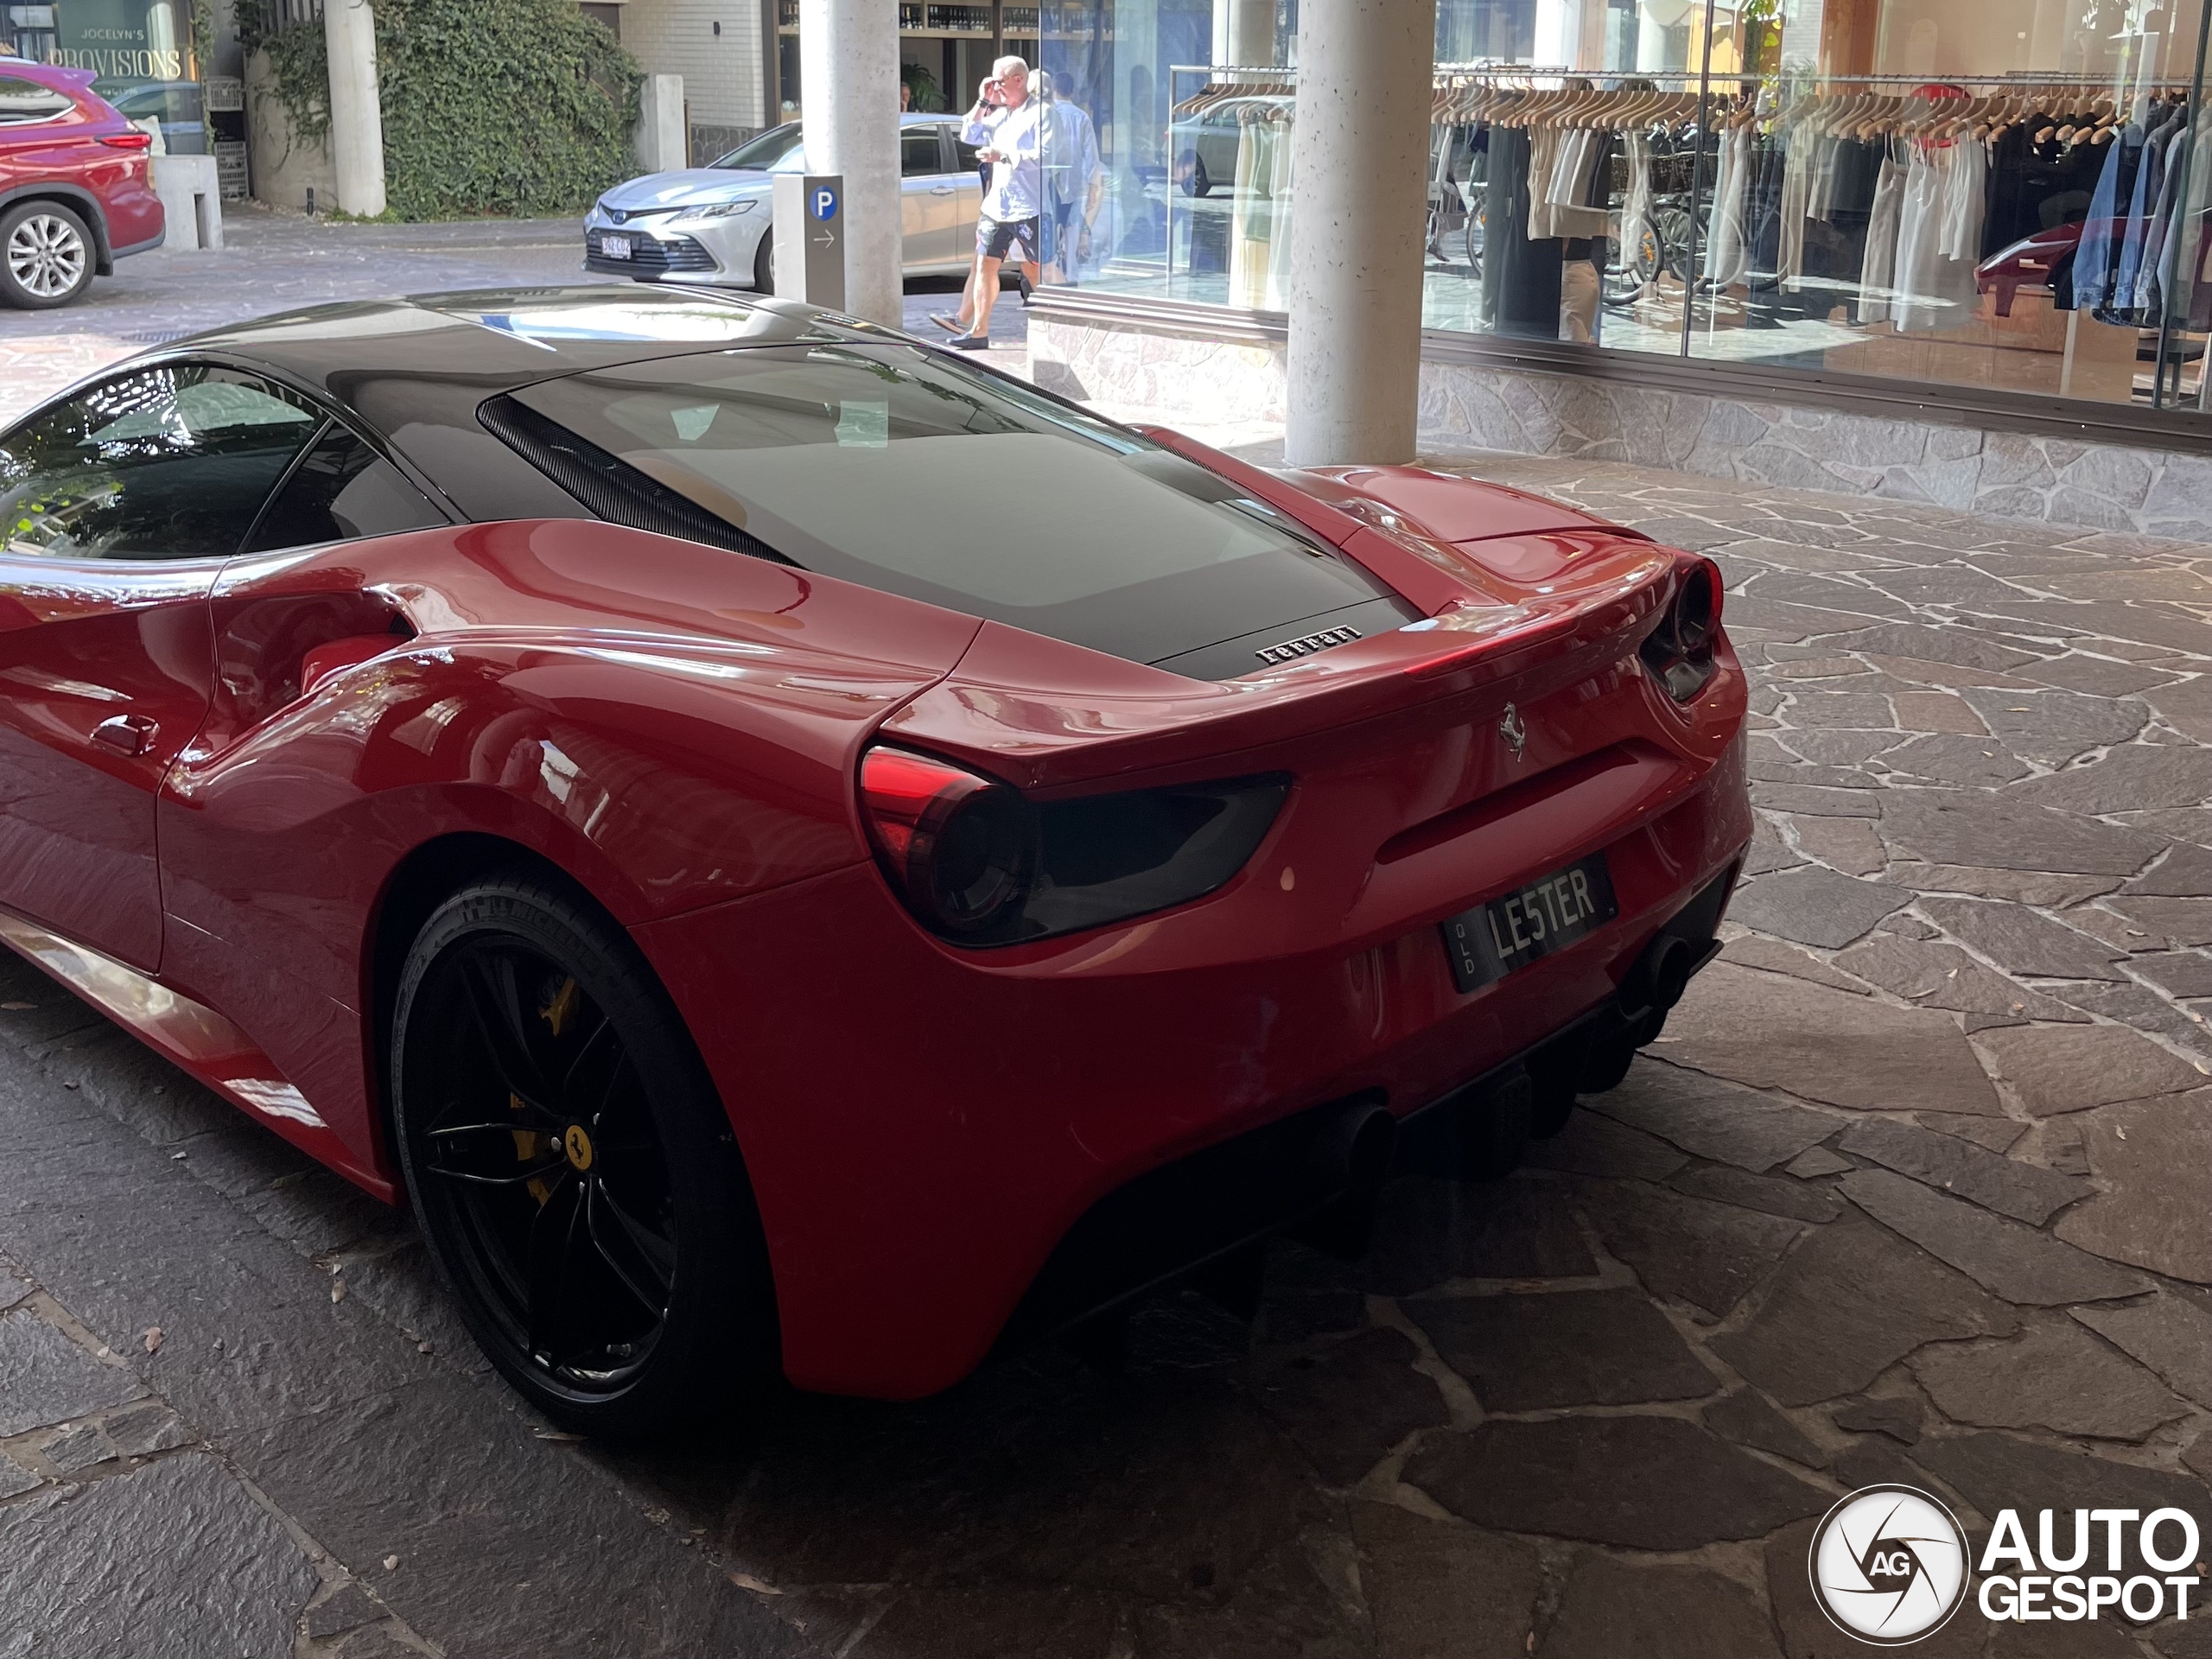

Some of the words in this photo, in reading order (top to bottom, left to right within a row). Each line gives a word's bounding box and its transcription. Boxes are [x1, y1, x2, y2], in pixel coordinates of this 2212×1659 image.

[81, 29, 145, 41] JOCELYN'S
[48, 48, 181, 80] PROVISIONS
[817, 191, 833, 216] P
[1255, 624, 1363, 664] Ferrari
[1487, 868, 1595, 959] LE5TER
[1455, 923, 1475, 975] QLD
